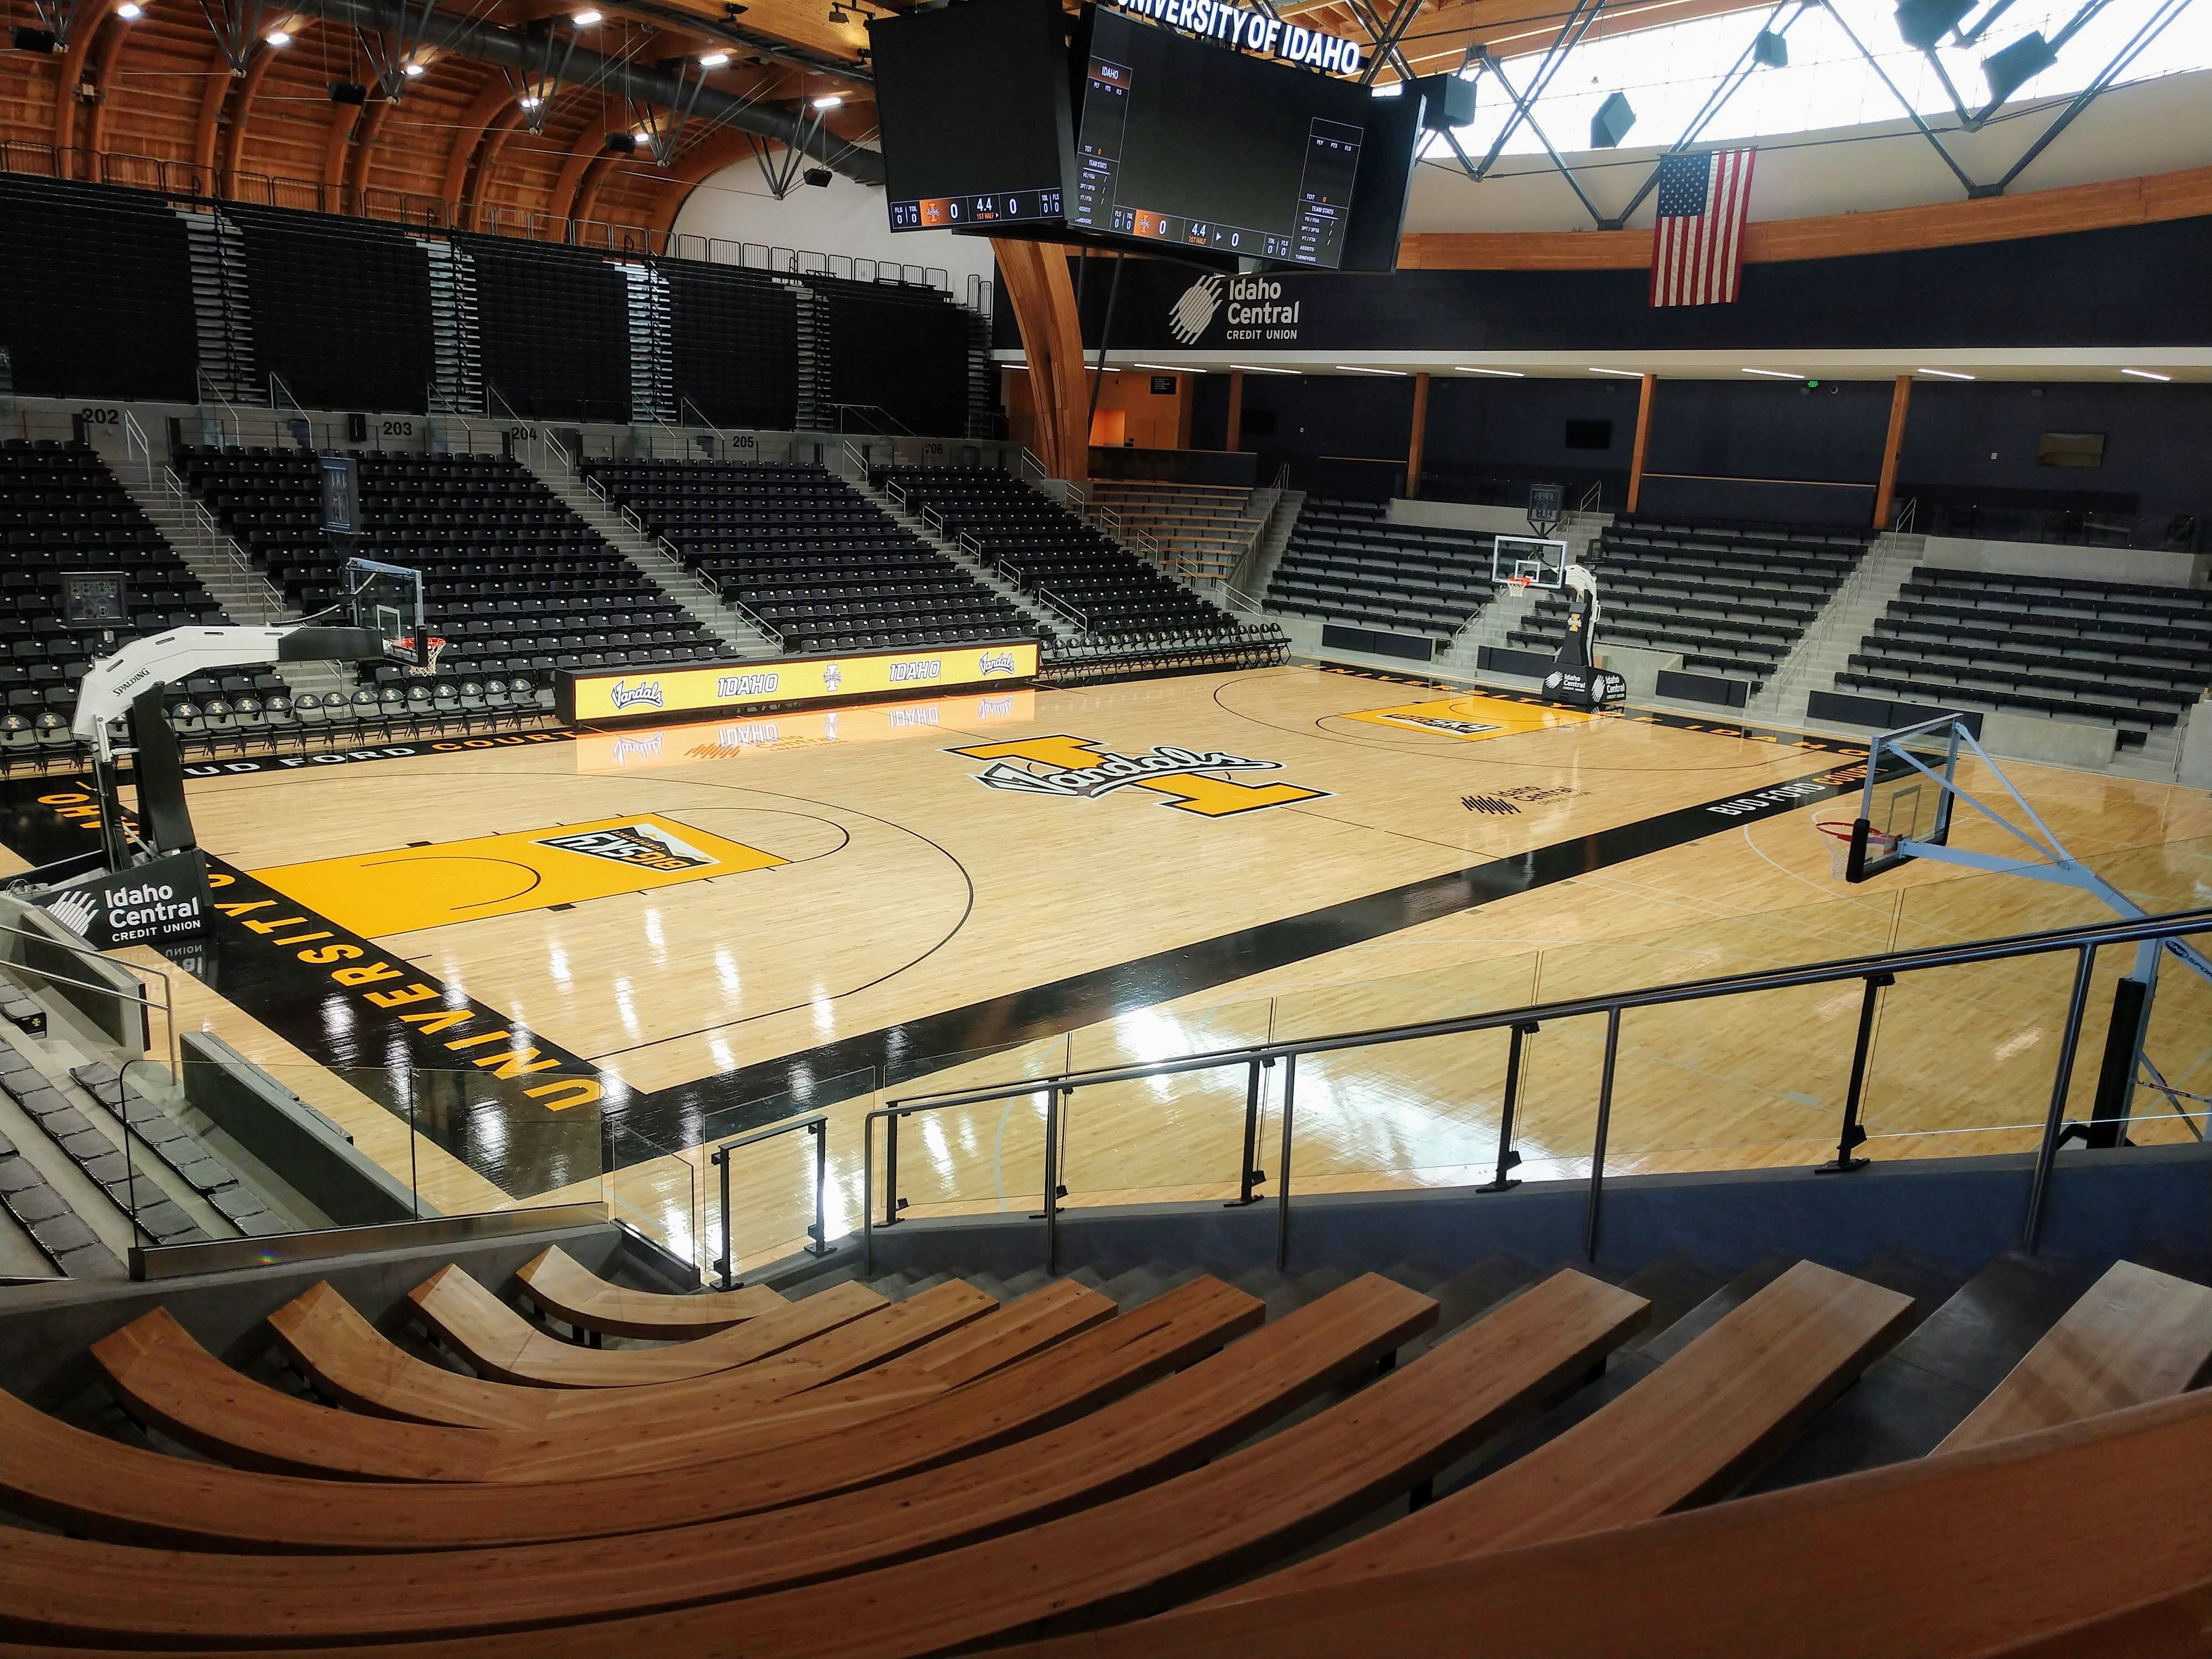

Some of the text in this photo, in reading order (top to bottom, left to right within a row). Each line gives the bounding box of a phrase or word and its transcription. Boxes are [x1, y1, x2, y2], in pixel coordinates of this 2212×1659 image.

[1248, 15, 1281, 52] OF
[1281, 24, 1360, 75] IDAHO
[1102, 66, 1119, 80] IDAHO
[950, 203, 958, 219] 0
[977, 197, 992, 212] 4.4
[1009, 199, 1018, 215] 0
[1044, 202, 1060, 213] 0 0
[897, 213, 917, 225] 0 0
[1114, 218, 1119, 228] 0
[1126, 221, 1131, 230] 0
[1159, 220, 1167, 234] 0
[1191, 223, 1207, 237] 4.4
[1197, 237, 1206, 245] HALF
[1231, 232, 1239, 247] 0
[1267, 245, 1286, 256] 0 0
[1229, 277, 1282, 301] Idaho
[1227, 300, 1300, 325] Central
[1227, 330, 1297, 340] CREDIT UNION
[82, 408, 119, 425] 202
[383, 421, 413, 436] 203
[733, 436, 754, 448] 205
[889, 660, 941, 682] IDAHO
[979, 651, 1015, 676] Vandals
[113, 667, 152, 697] SPALDING
[718, 674, 779, 697] IDAHO
[1563, 680, 1585, 688] Central
[1564, 674, 1580, 682] Idaho
[1605, 675, 1619, 684] Idaho
[611, 680, 664, 711] Vandals
[1606, 683, 1625, 693] Central
[1300, 664, 1576, 708] UNIVERSITY
[1684, 724, 1871, 757] IDAHO
[1431, 719, 1501, 732] SKY
[755, 736, 839, 749] Central
[183, 731, 577, 775] UD FORD COURT
[968, 745, 1287, 800] Vandals
[1489, 786, 1542, 797] Idaho
[1513, 786, 1578, 802] Central
[1705, 799, 1770, 816] BUD
[1755, 783, 1827, 802] FORD
[548, 833, 692, 870] BIG SKY
[105, 883, 173, 909] Idaho
[109, 896, 200, 928] Central
[112, 920, 201, 942] CREDIT UNION
[213, 899, 607, 1113] UNIVERSITY
